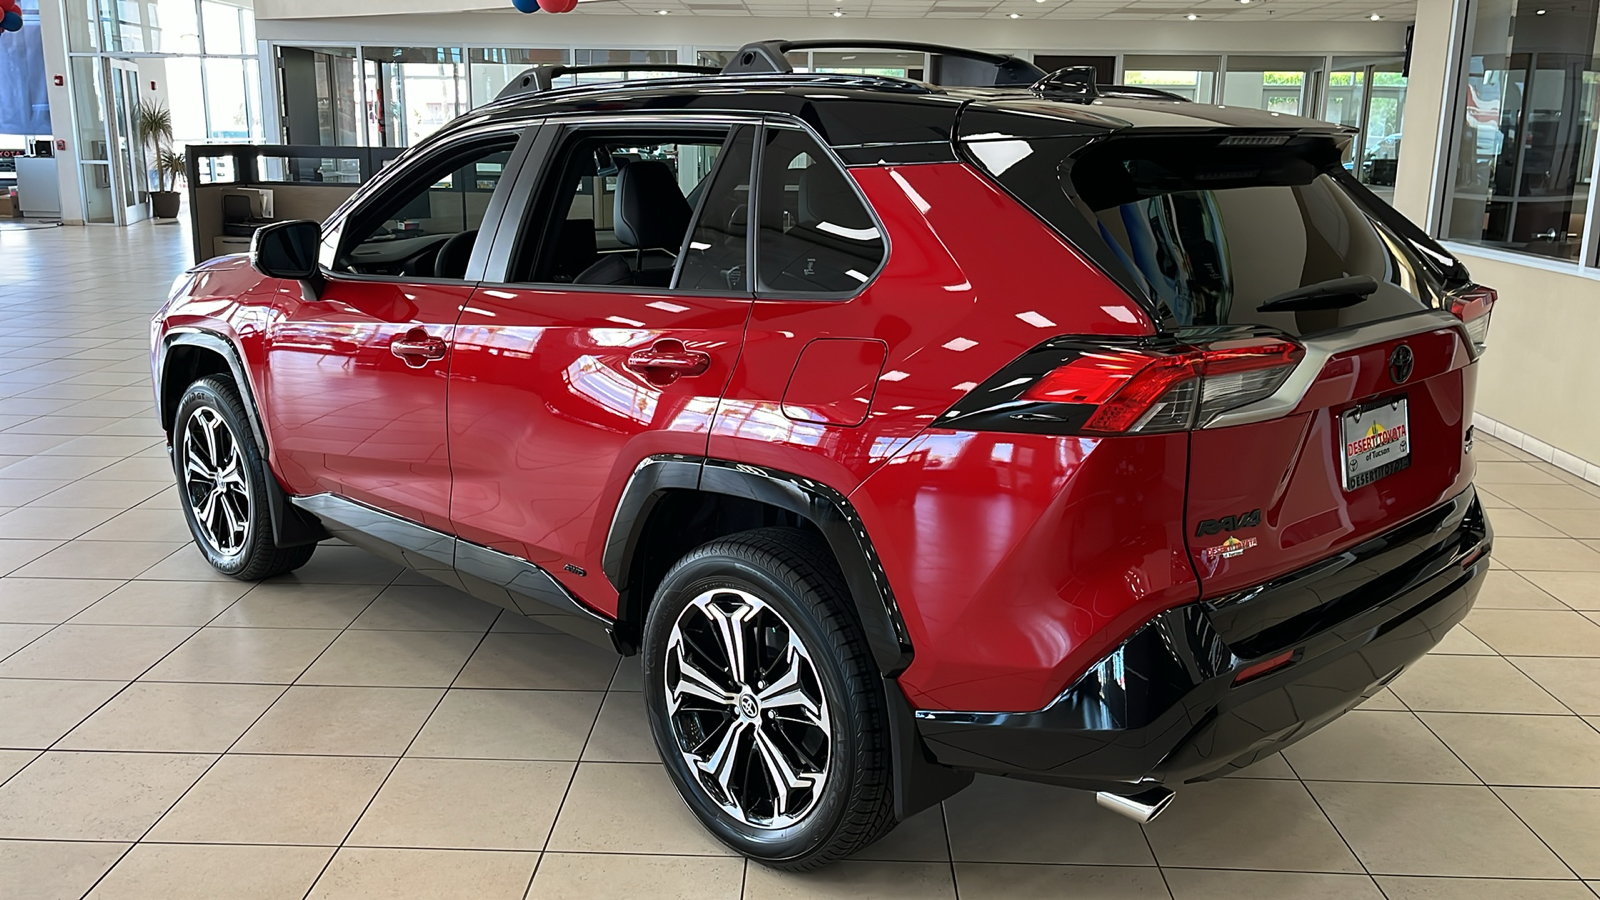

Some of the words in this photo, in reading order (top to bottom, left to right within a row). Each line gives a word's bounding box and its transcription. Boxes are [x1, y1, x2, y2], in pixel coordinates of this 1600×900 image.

[1347, 435, 1376, 457] DESERT
[1378, 424, 1406, 446] TOYOTA
[1365, 452, 1372, 461] of
[1372, 447, 1390, 458] Tucson
[1350, 469, 1378, 489] DESERT
[1195, 508, 1262, 537] RAV4
